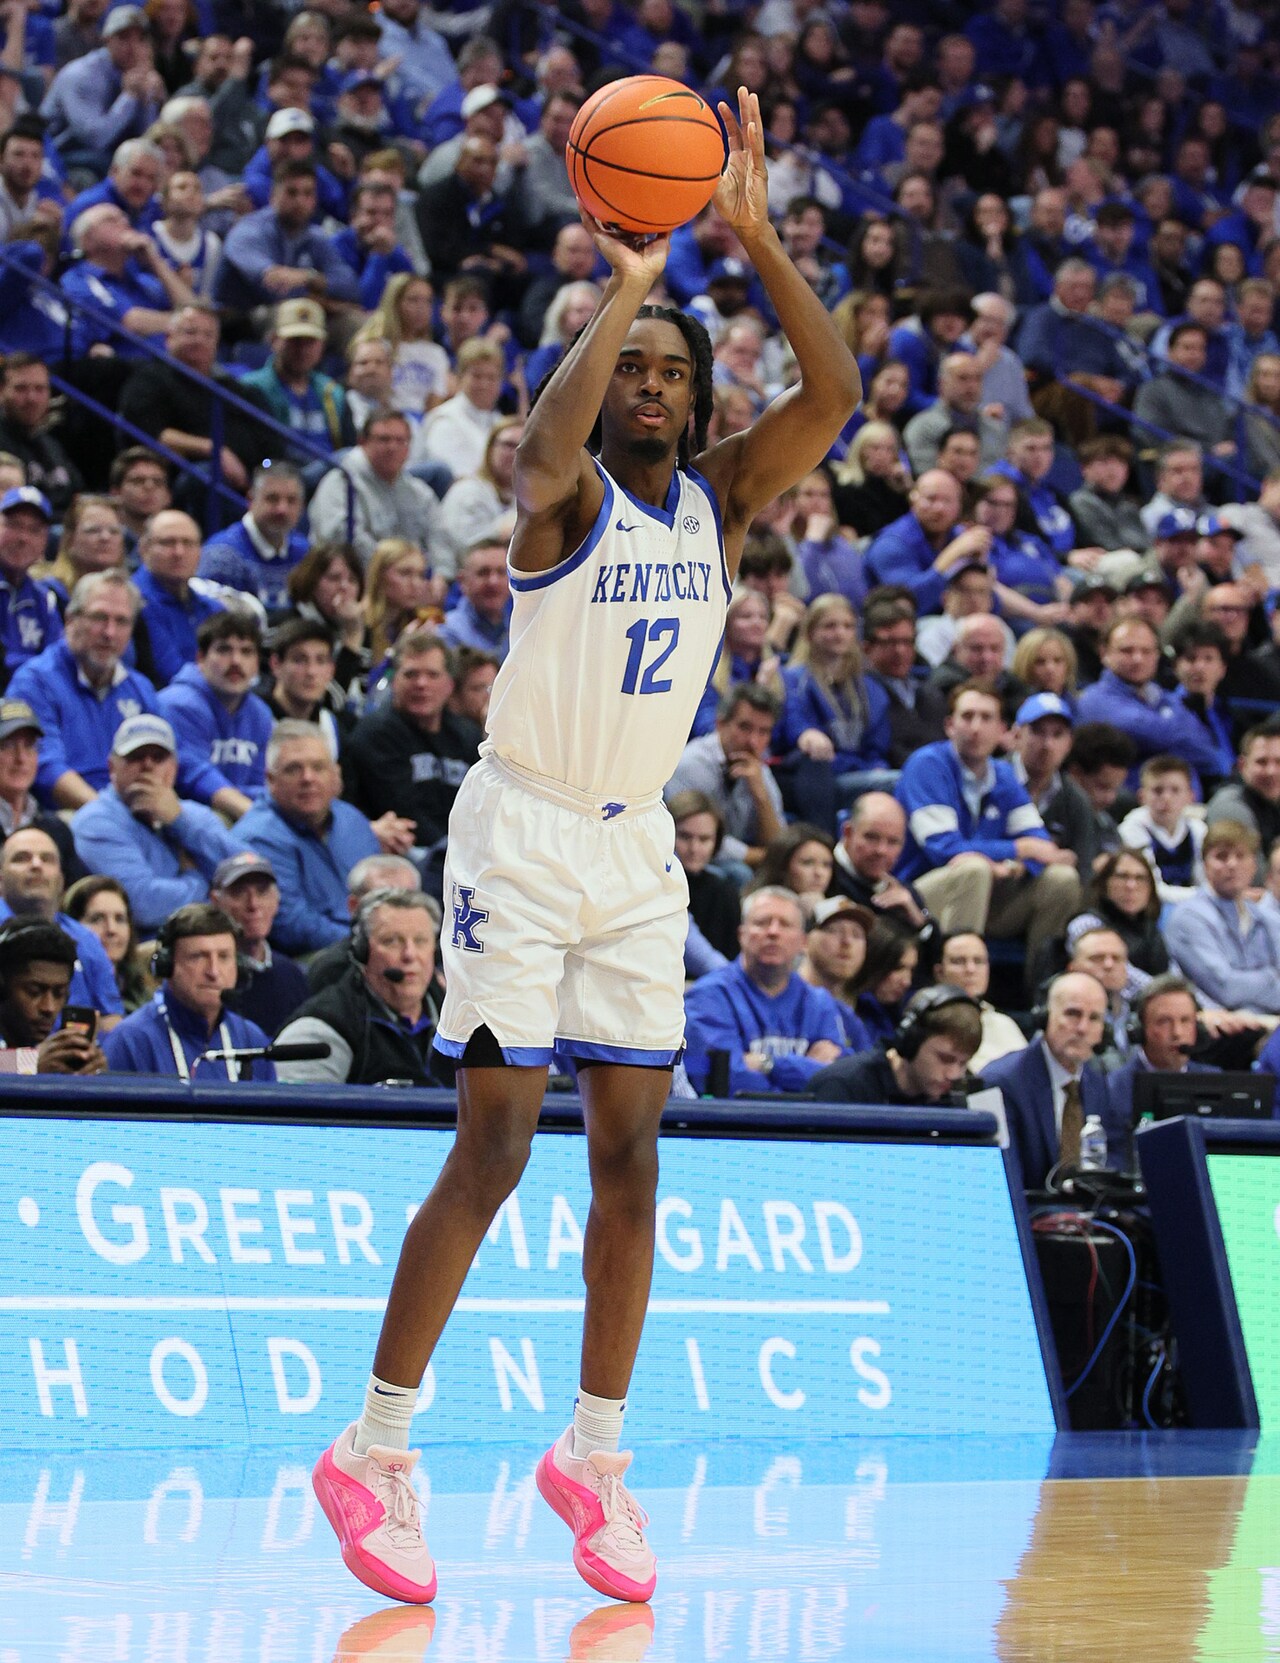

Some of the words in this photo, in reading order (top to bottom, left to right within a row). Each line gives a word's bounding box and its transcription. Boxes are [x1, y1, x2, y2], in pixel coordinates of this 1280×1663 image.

[683, 516, 700, 534] SEC
[591, 561, 711, 603] KENTUCKY
[621, 617, 680, 695] 12
[76, 1162, 383, 1265] GREER
[470, 1189, 863, 1273] MAGARD
